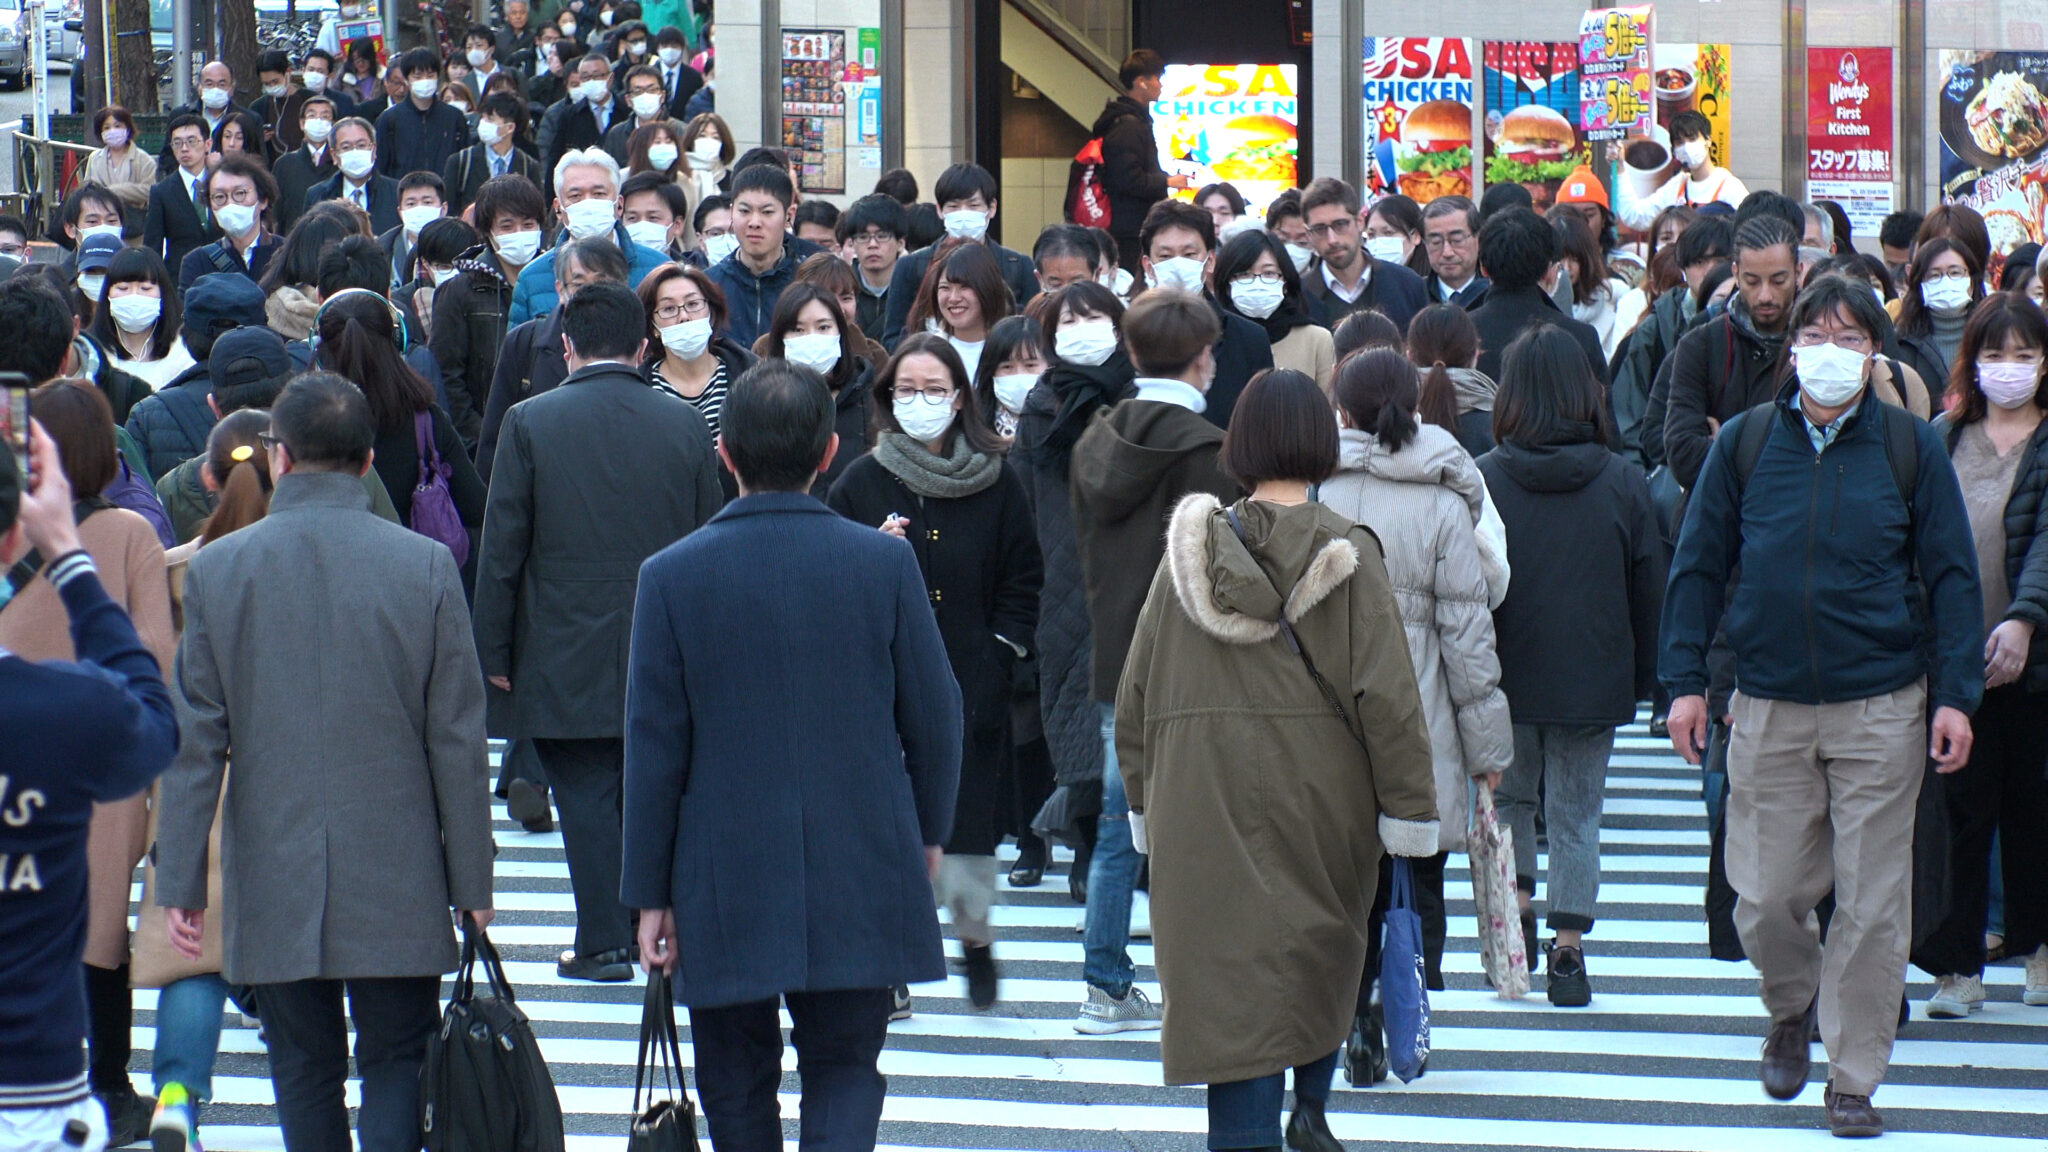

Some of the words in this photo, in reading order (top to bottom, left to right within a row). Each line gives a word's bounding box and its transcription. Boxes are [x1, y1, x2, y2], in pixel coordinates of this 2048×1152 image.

[1363, 37, 1472, 79] USA
[1173, 65, 1294, 97] SA
[1363, 81, 1472, 102] CHICKEN
[1484, 40, 1580, 124] USA
[1828, 80, 1869, 105] Wendy's
[1836, 106, 1861, 119] First
[1828, 123, 1870, 136] Kitchen
[1810, 149, 1890, 171] スタッフ募集!
